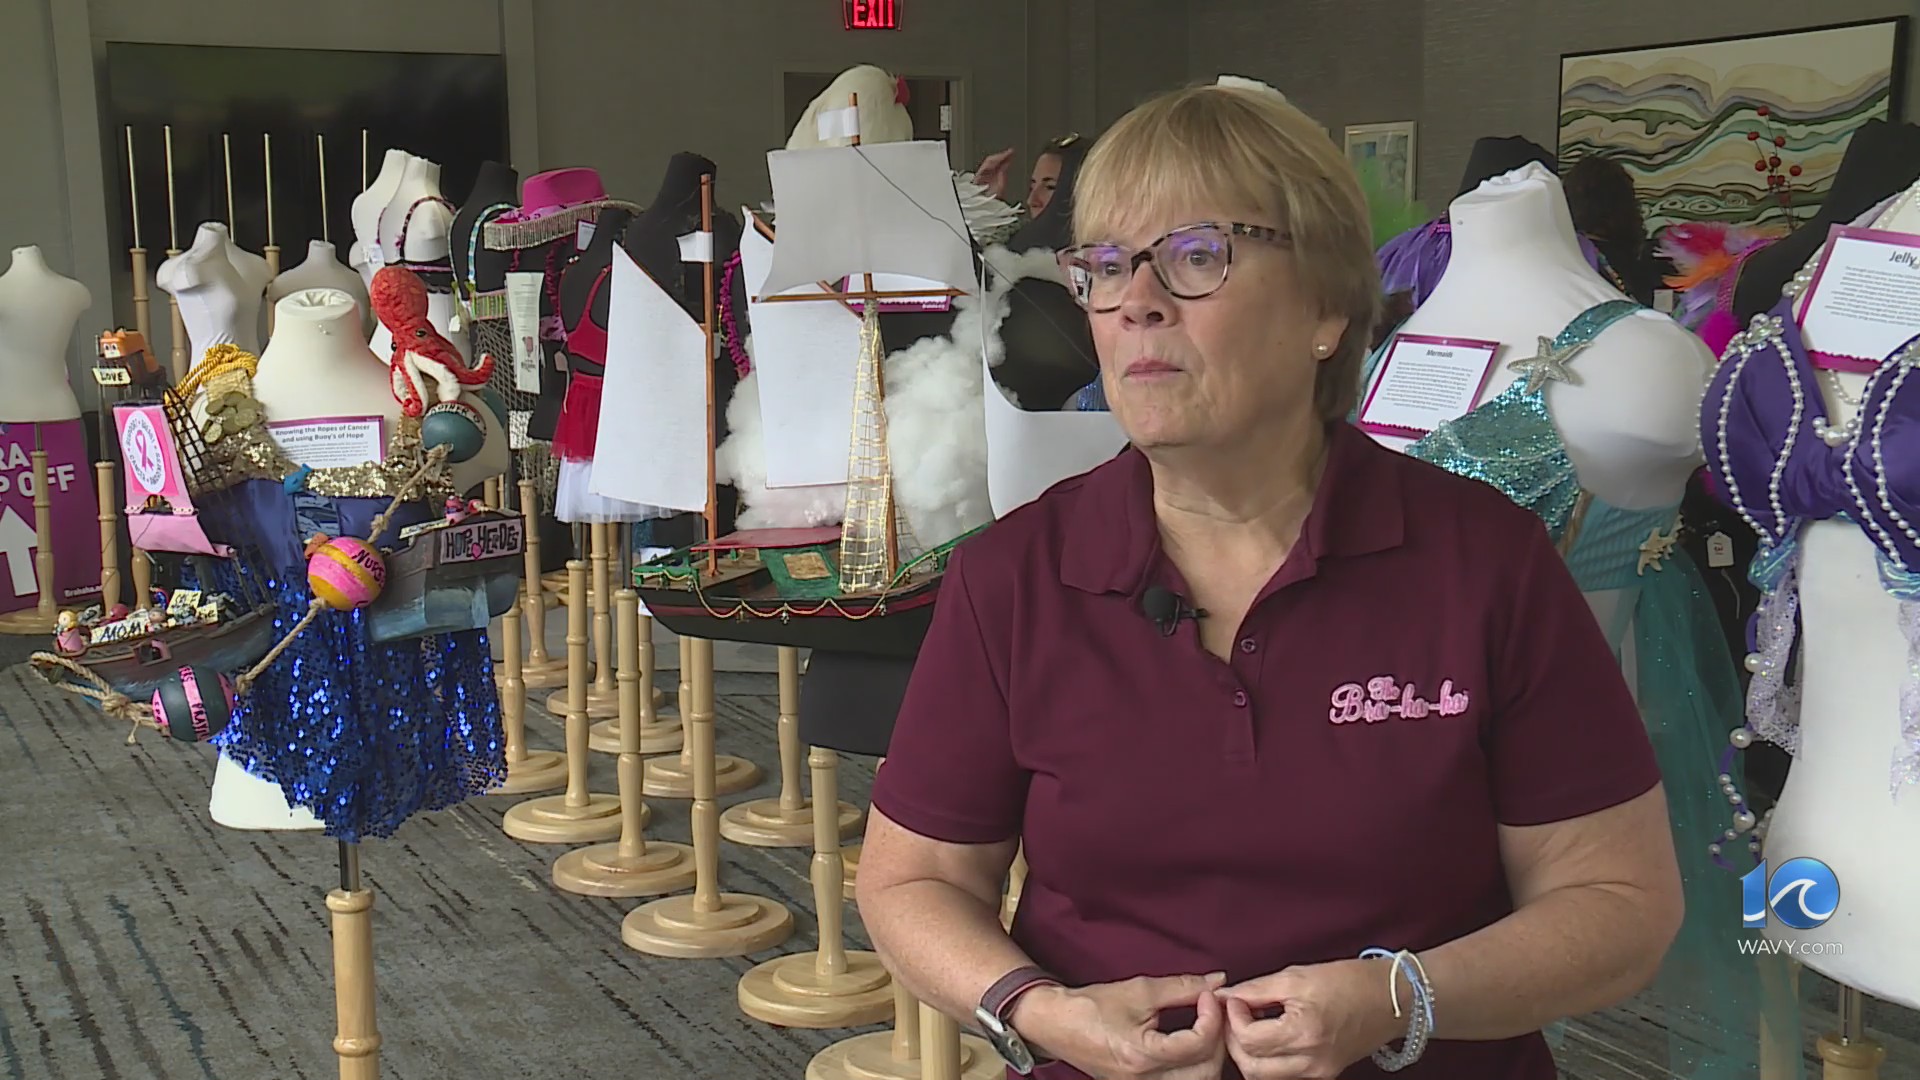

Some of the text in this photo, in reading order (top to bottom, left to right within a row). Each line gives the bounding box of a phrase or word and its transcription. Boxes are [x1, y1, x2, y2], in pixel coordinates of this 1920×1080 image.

[853, 0, 893, 27] EXIT
[101, 371, 123, 381] LOVE
[275, 428, 303, 436] Knowing
[317, 425, 337, 433] Ropes
[346, 432, 364, 440] Hope
[100, 622, 141, 641] MOM
[1368, 676, 1400, 700] The
